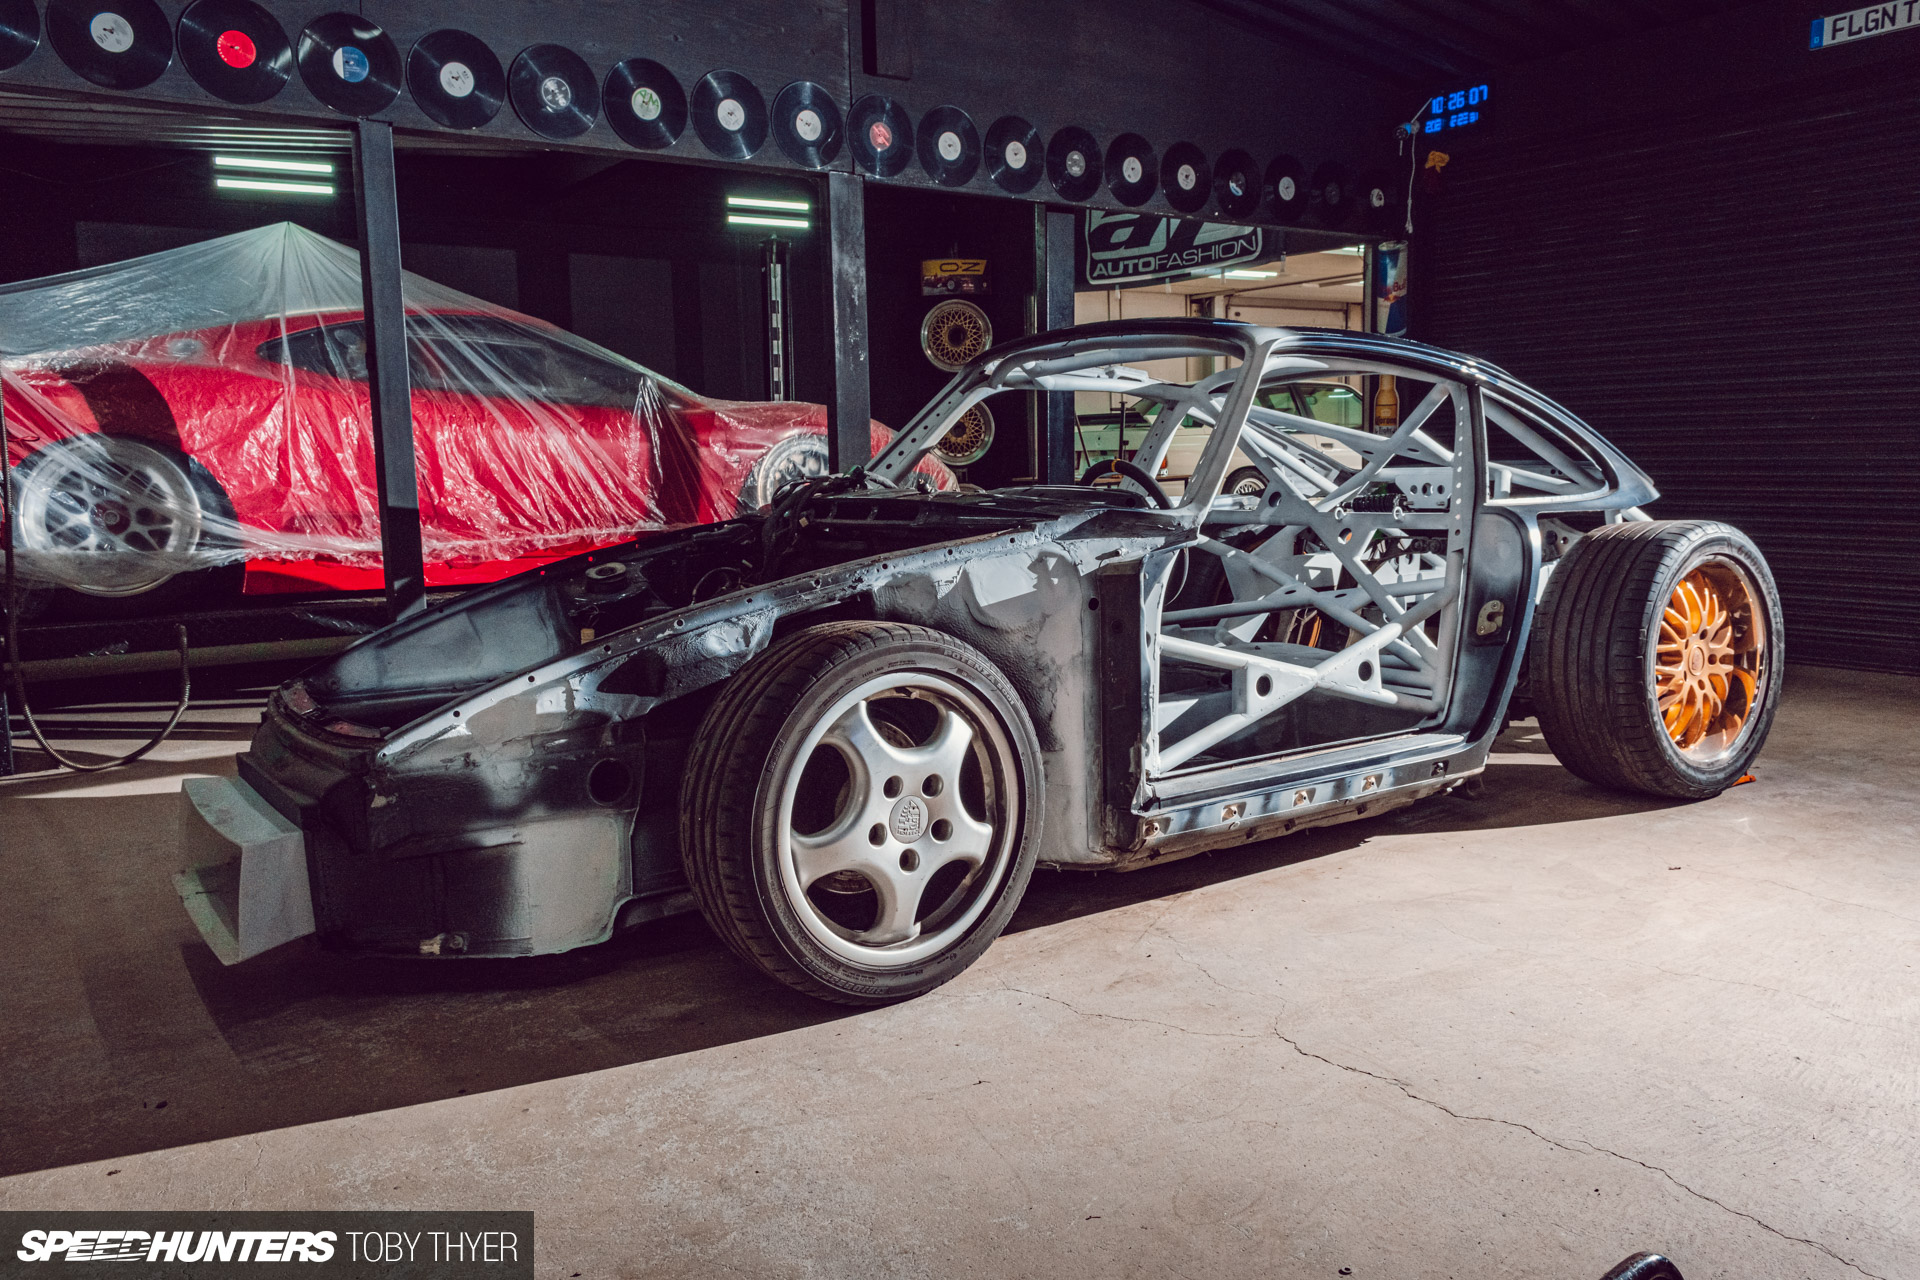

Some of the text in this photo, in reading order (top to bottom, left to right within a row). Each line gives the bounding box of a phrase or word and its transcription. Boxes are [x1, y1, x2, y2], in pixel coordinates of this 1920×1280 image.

[1831, 0, 1920, 40] FLGN T
[1092, 235, 1257, 278] AUTOFASHION
